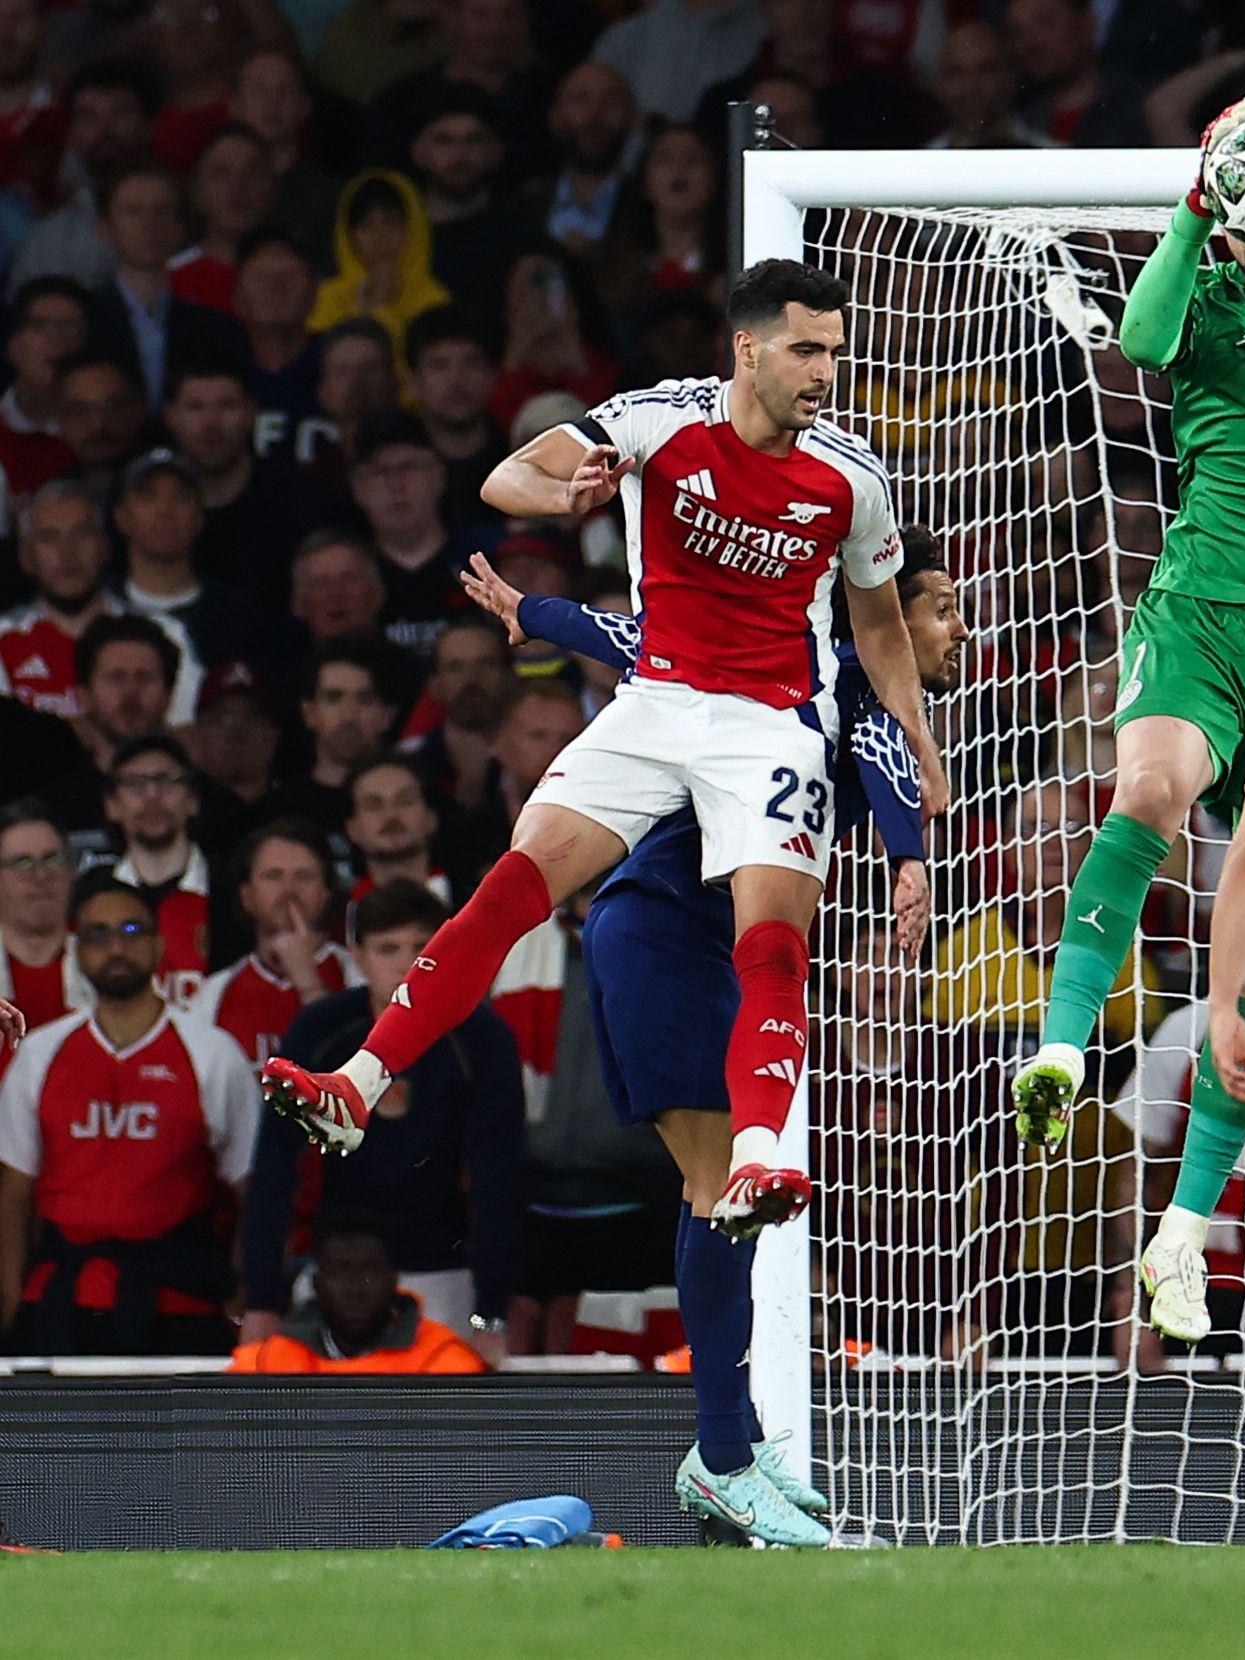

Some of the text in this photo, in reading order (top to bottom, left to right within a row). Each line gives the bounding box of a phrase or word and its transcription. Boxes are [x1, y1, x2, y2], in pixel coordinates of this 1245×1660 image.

[673, 491, 818, 561] Emirates
[684, 530, 789, 579] FLY BETTER
[766, 766, 828, 835] 23
[759, 1018, 805, 1048] AFC
[70, 1099, 158, 1139] JVC
